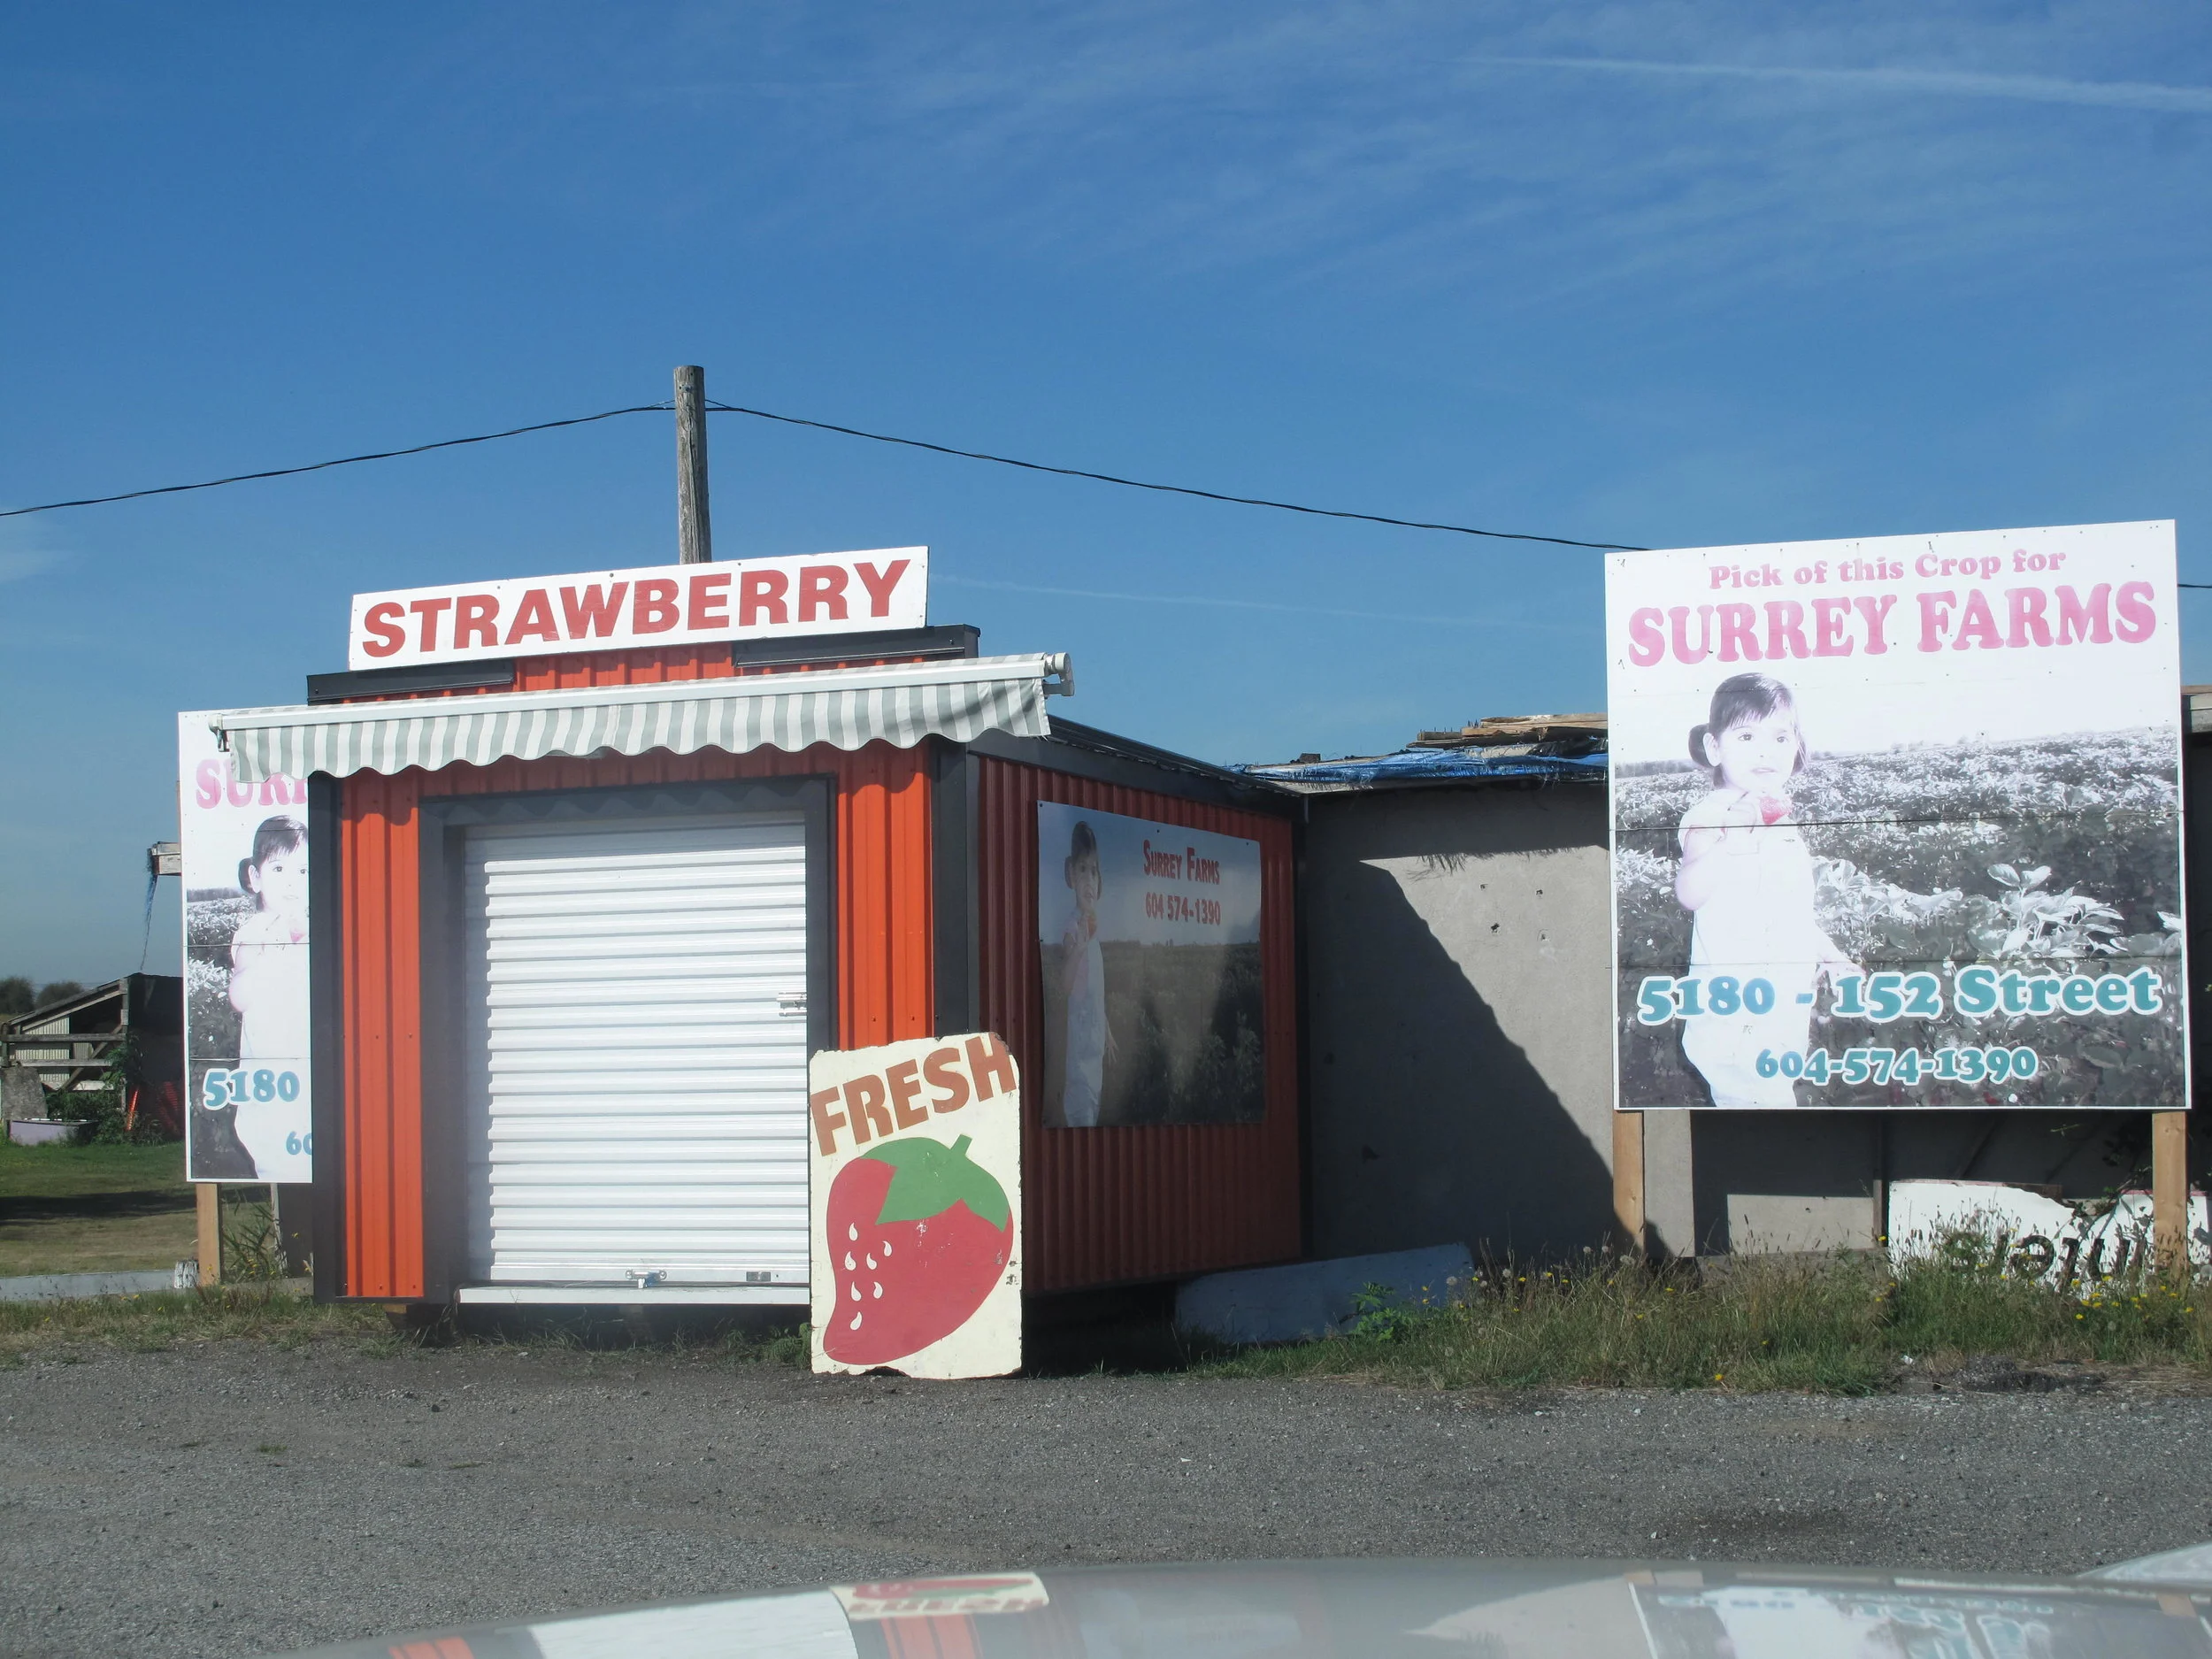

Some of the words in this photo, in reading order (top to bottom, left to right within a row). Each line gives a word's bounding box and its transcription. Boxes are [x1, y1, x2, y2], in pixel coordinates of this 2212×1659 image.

[1709, 564, 1783, 590] Pick
[1793, 560, 1828, 584] of
[1838, 556, 1905, 582] this
[1915, 552, 2002, 580] Crop
[2012, 548, 2067, 573] for
[362, 558, 910, 657] STRAWBERRY
[1628, 594, 1898, 667] SURREY
[1916, 580, 2156, 653] FARMS
[1145, 891, 1165, 920] 604
[1167, 895, 1221, 926] 574-1390
[1638, 976, 1777, 1025] 5180
[1832, 972, 1941, 1021] 152
[1955, 966, 2163, 1016] Street
[204, 1068, 301, 1109] 5180
[1755, 1048, 2039, 1085] 604-574-1390
[810, 1033, 1017, 1157] FRESH
